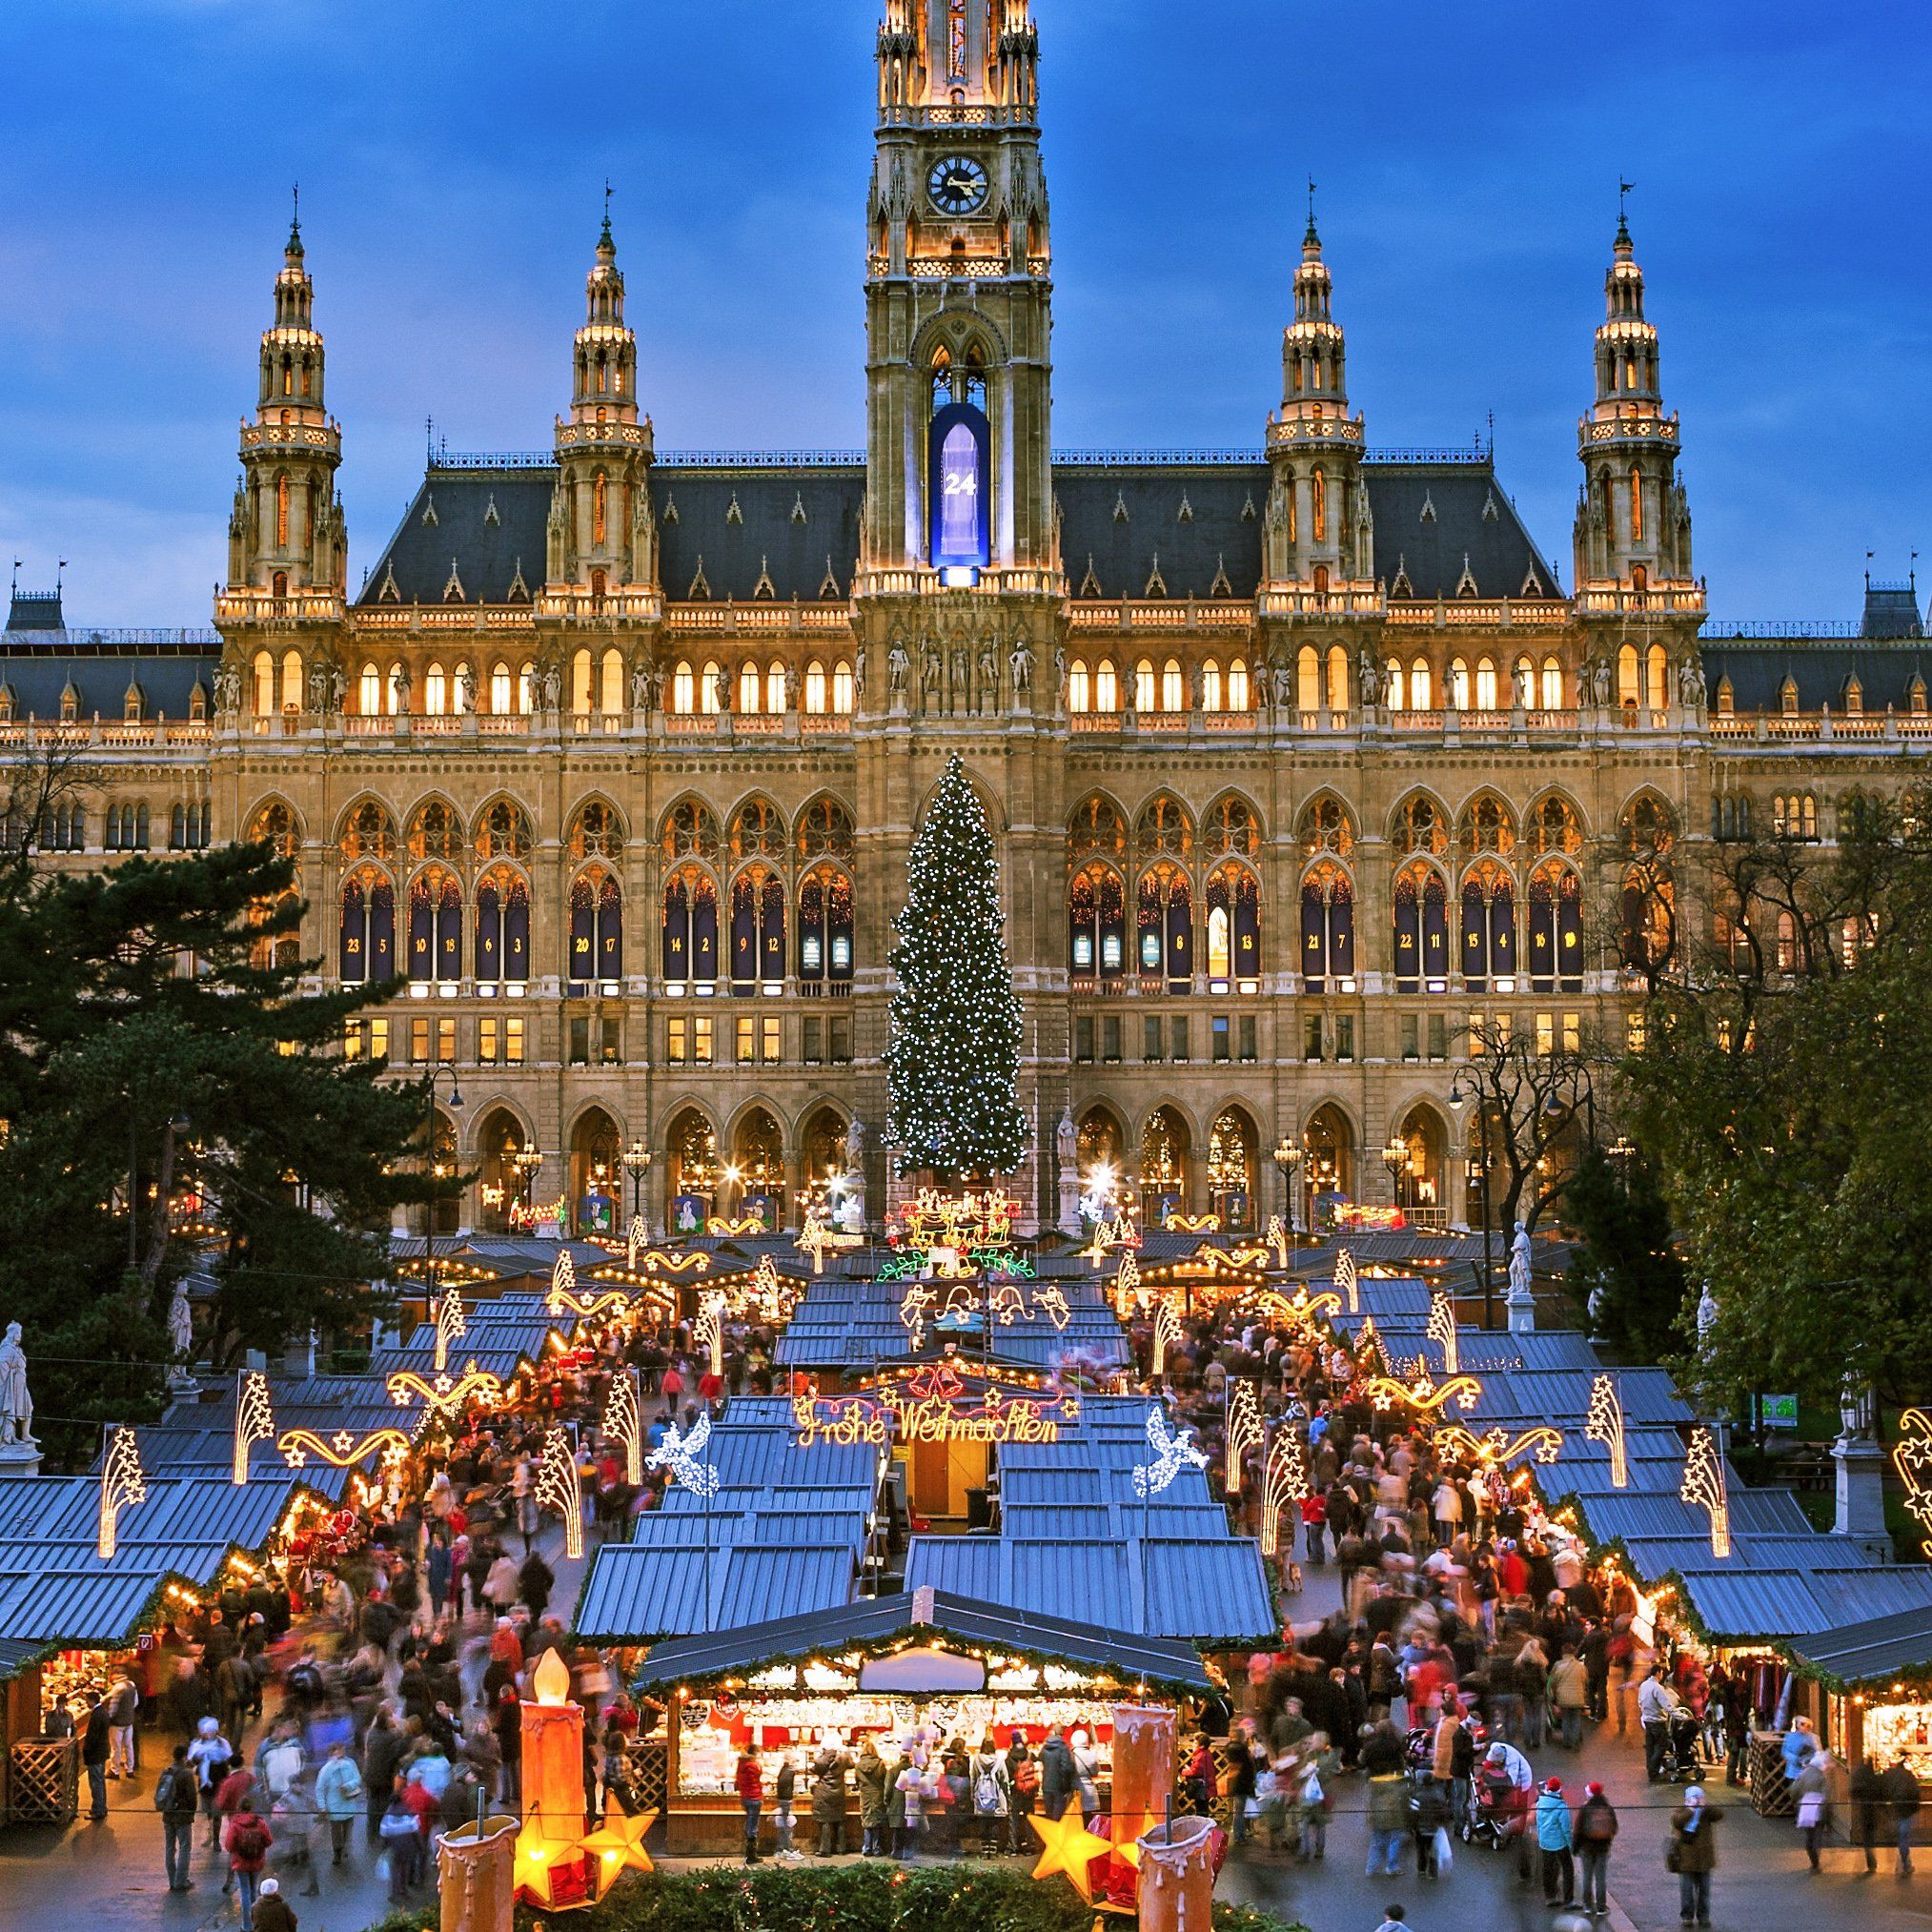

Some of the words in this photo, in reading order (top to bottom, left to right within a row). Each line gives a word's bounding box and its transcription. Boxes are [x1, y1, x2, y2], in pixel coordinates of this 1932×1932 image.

[945, 473, 976, 496] 24
[347, 937, 360, 953] 23
[379, 938, 387, 953] 5
[416, 938, 427, 953] 10
[484, 938, 493, 952] 6
[514, 937, 521, 953] 3
[576, 937, 590, 953] 20
[605, 937, 616, 952] 17
[671, 937, 681, 952] 14
[702, 937, 709, 952] 2
[740, 937, 747, 952] 9
[768, 937, 779, 952] 12
[1308, 934, 1319, 950] 21
[1338, 934, 1346, 949] 7
[1399, 933, 1413, 949] 22
[1431, 933, 1440, 948] 11
[1467, 932, 1479, 948] 15
[1498, 932, 1508, 948] 4
[1535, 931, 1546, 948] 16
[798, 1397, 886, 1446] Frohe
[891, 1397, 1057, 1444] Weihnachten
